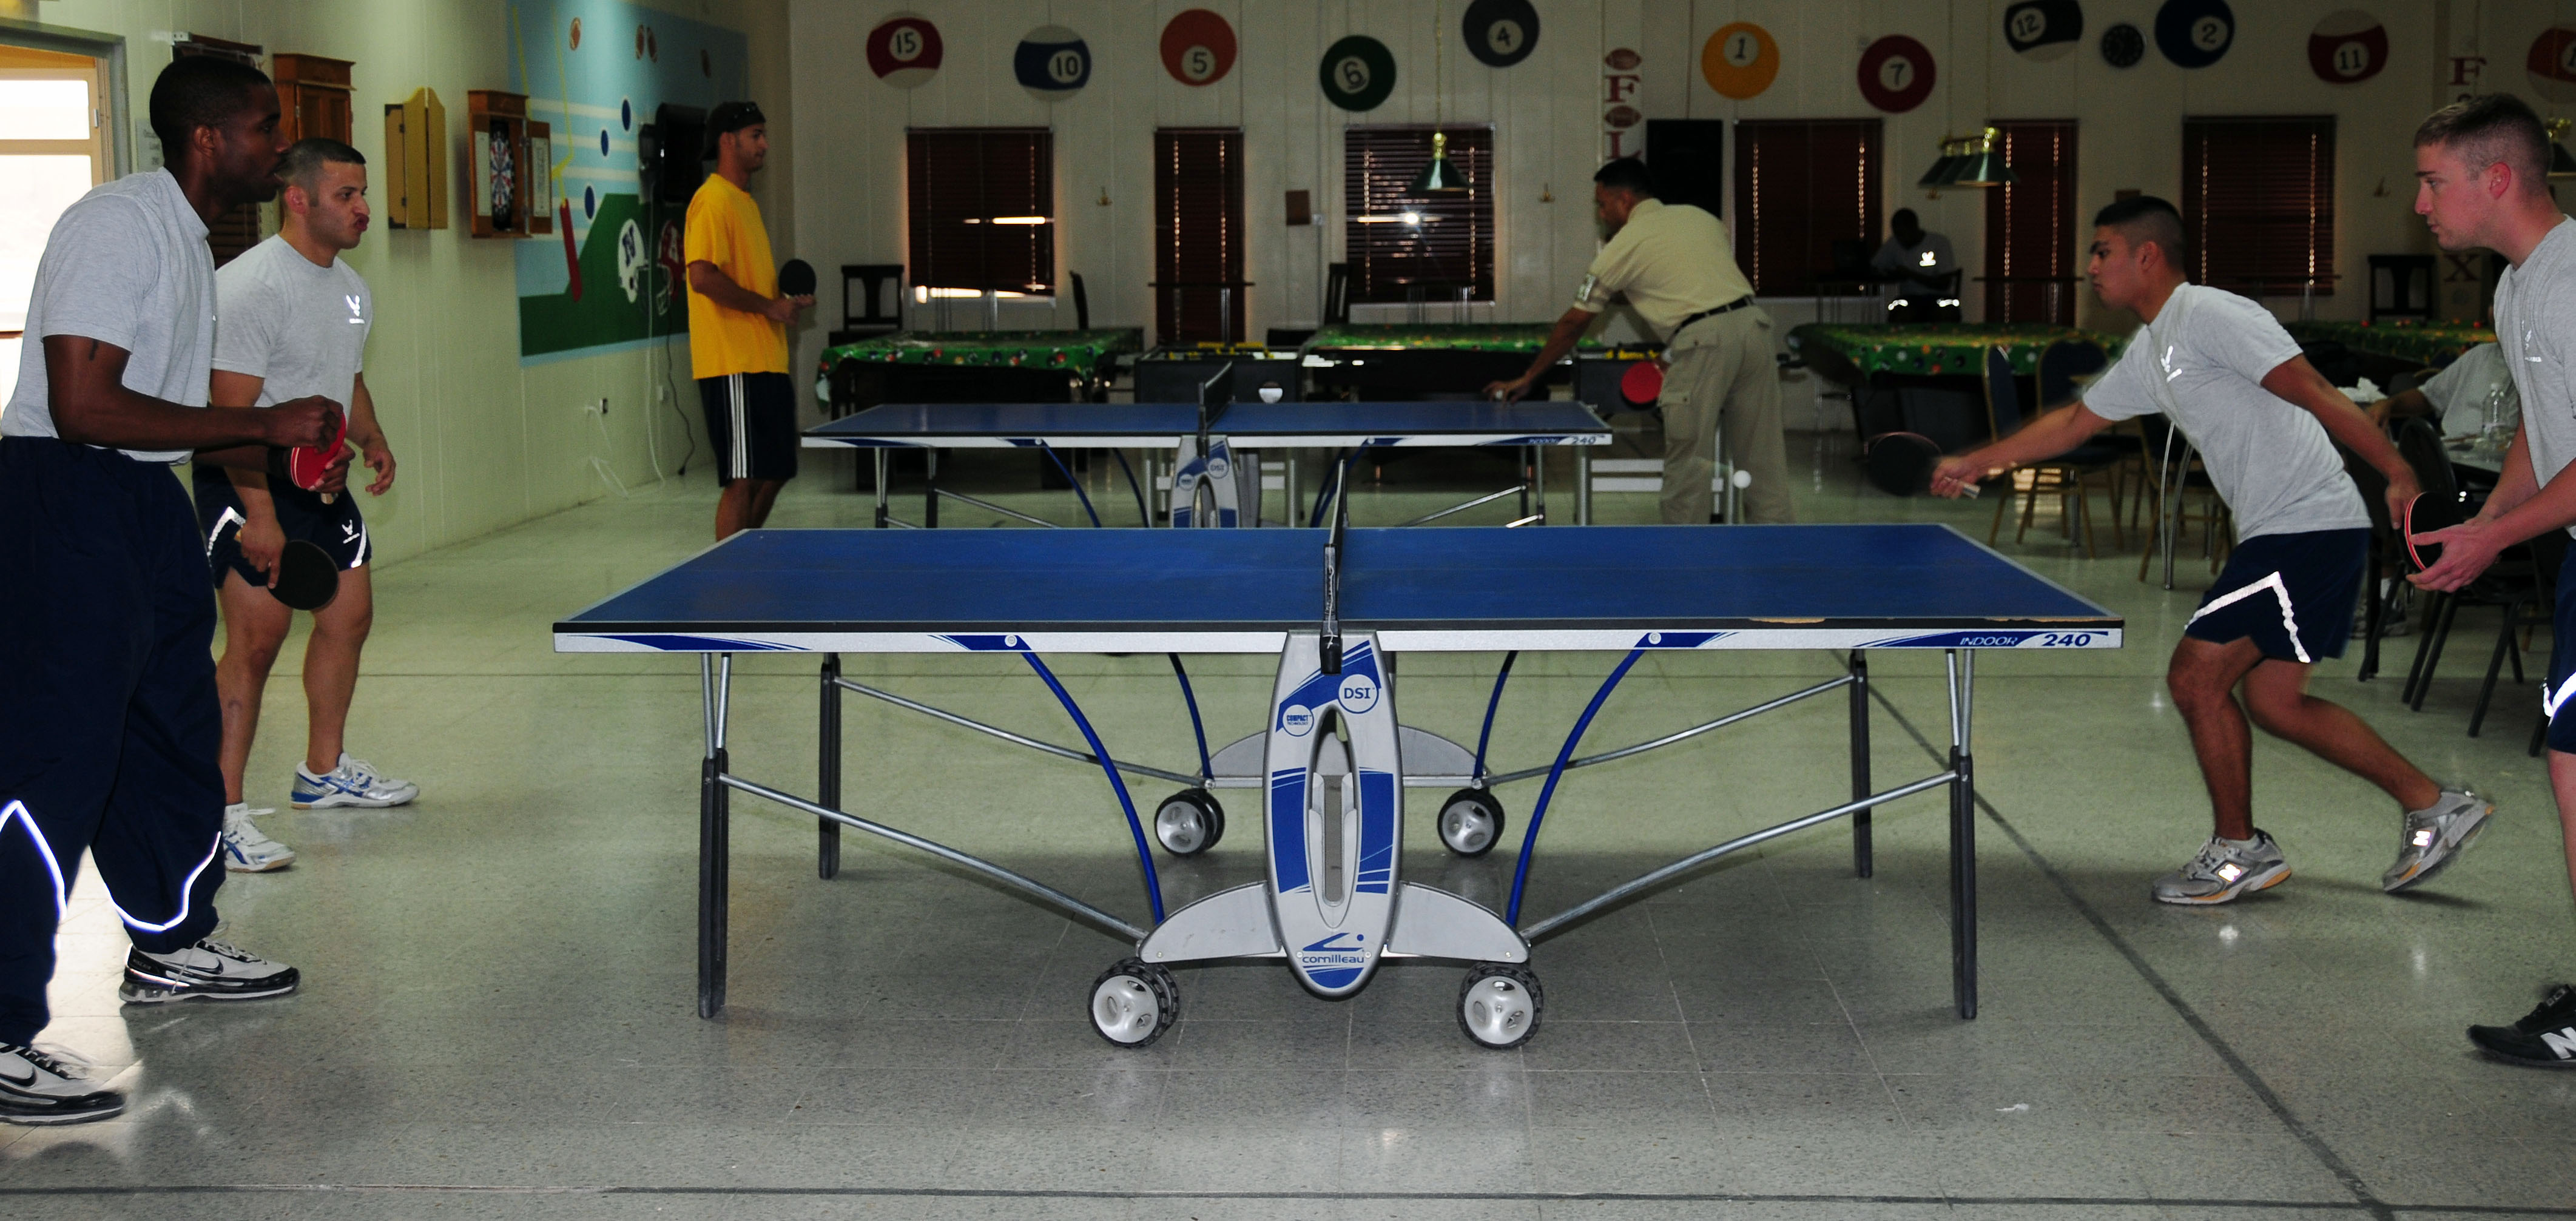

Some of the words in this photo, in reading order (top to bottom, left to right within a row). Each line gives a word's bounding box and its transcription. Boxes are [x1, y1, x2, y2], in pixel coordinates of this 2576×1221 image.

[2016, 14, 2040, 37] 12
[2202, 23, 2217, 44] 2
[896, 31, 917, 55] 15
[1497, 27, 1510, 48] 4
[1735, 37, 1746, 60] 1
[1056, 55, 1079, 77] 10
[1193, 50, 1207, 74] 5
[2339, 49, 2361, 70] 11
[1344, 61, 1364, 89] 6
[1889, 62, 1906, 86] 7
[1959, 636, 2018, 646] INDOOR
[2041, 633, 2091, 647] 240
[1344, 687, 1371, 699] DSI
[1302, 954, 1364, 964] cornilleau
